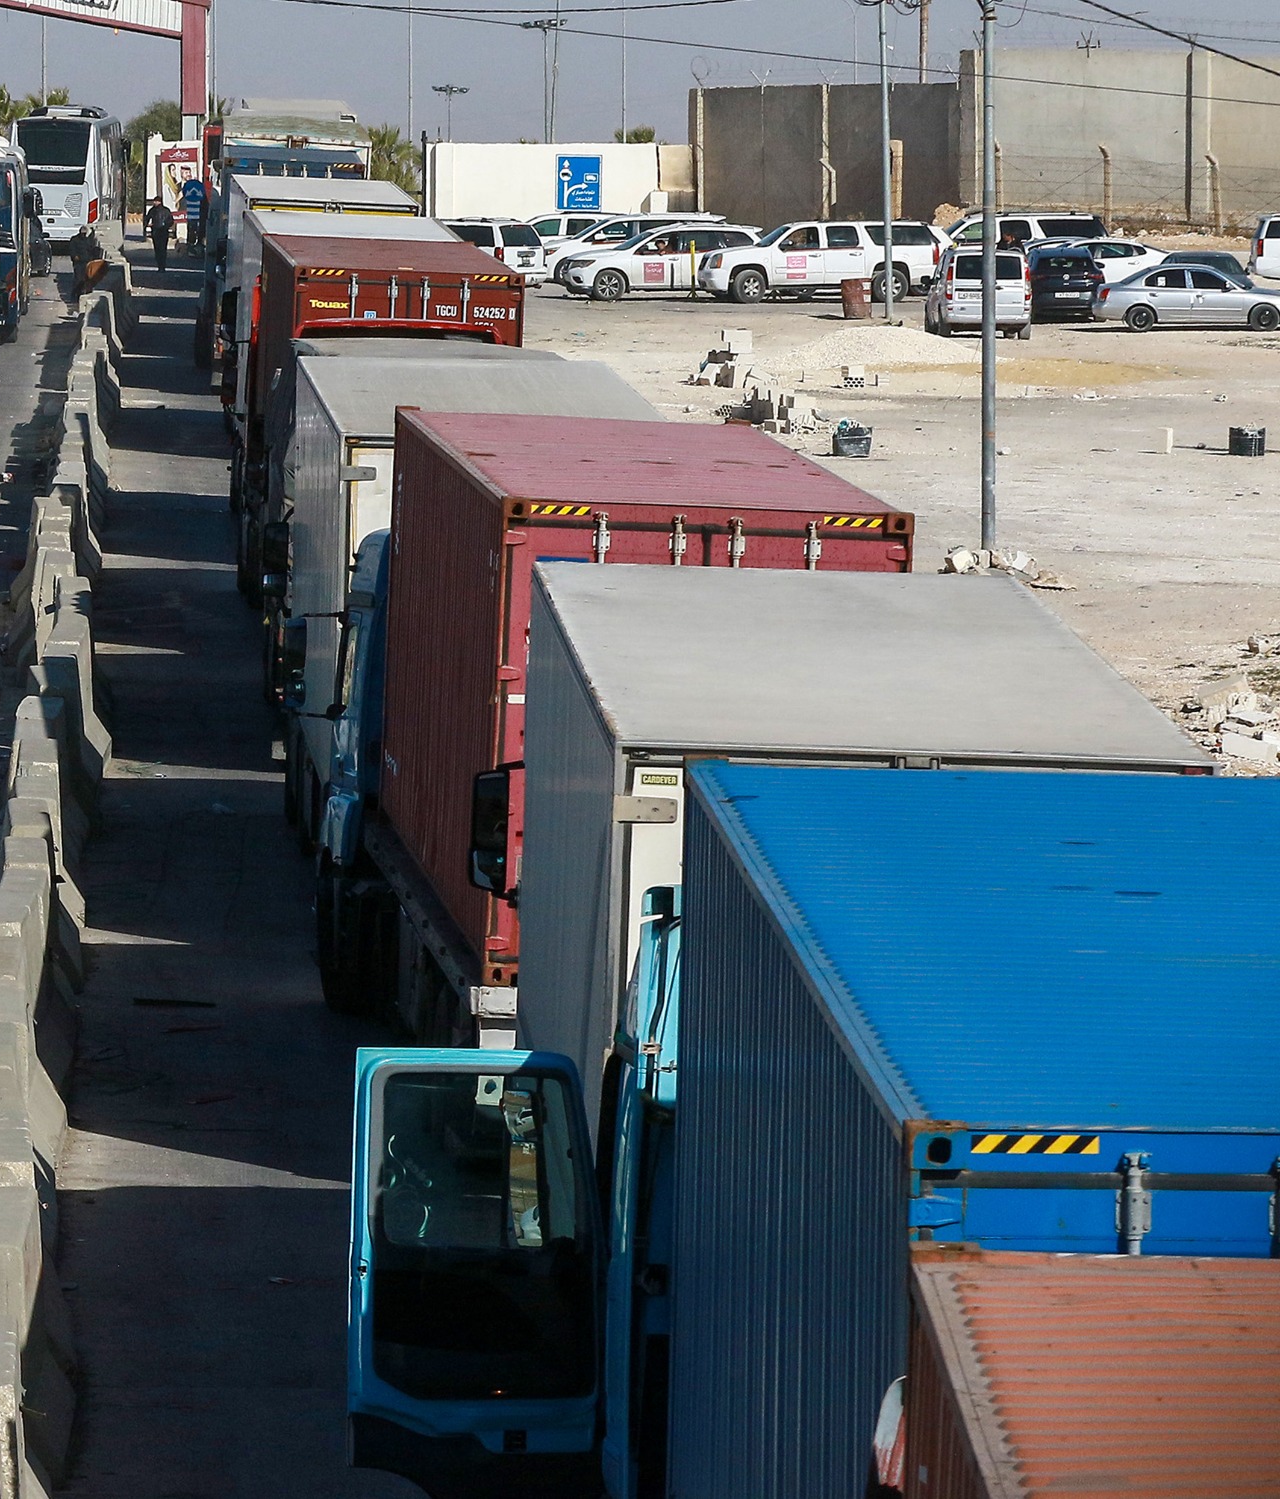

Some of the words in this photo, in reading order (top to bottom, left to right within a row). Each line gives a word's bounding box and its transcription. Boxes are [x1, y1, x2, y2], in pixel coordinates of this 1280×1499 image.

[309, 299, 350, 309] Touax
[435, 304, 457, 317] TGCU
[473, 306, 506, 320] 524252
